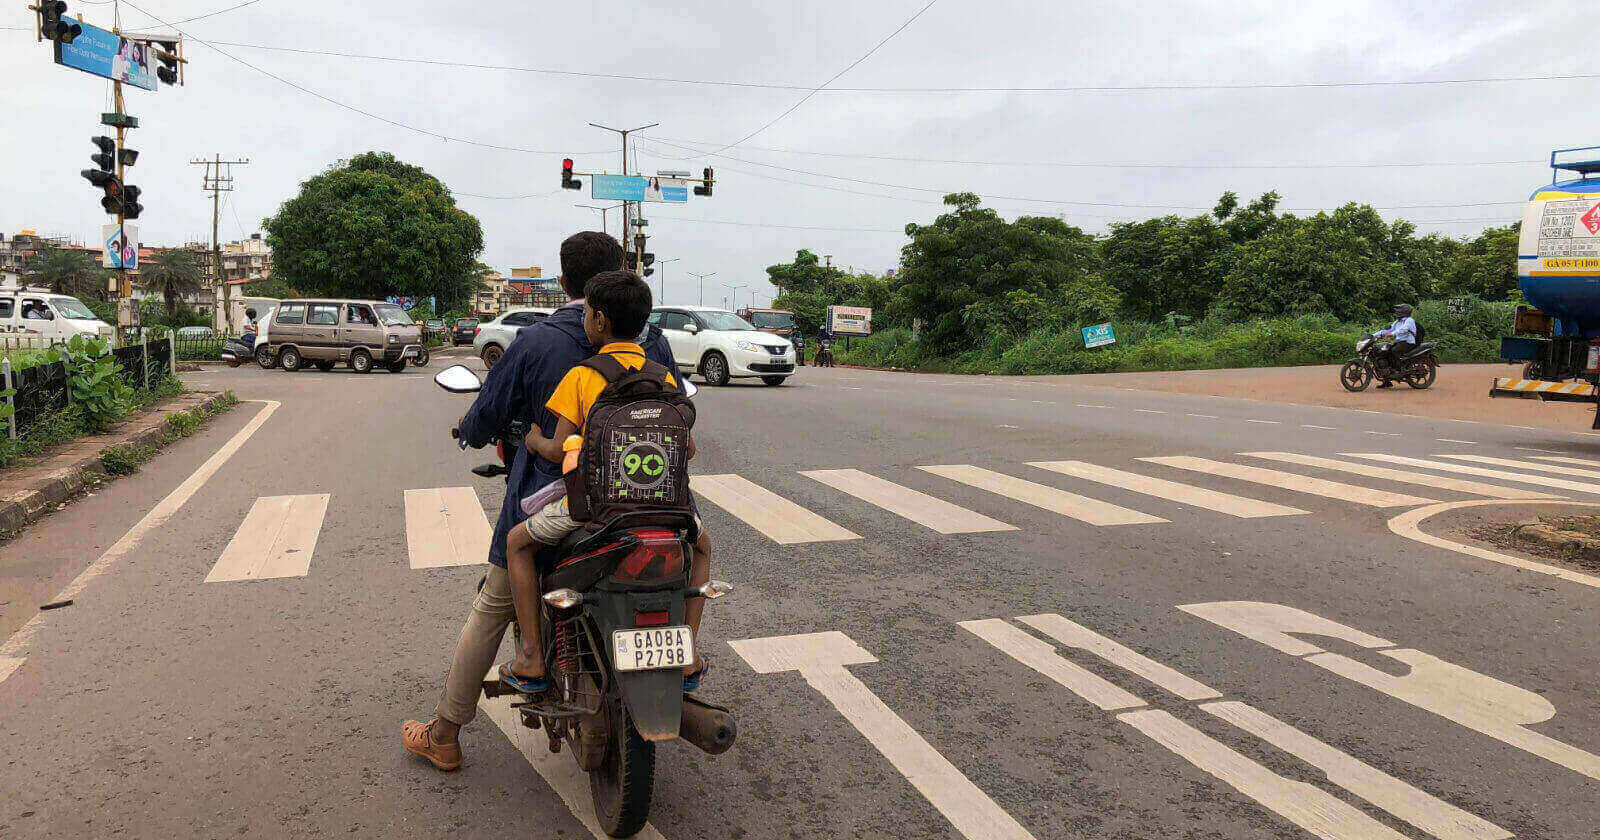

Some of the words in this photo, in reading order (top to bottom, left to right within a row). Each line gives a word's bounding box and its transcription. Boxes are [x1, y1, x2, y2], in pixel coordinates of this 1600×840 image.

[1547, 260, 1560, 268] GA
[624, 453, 664, 476] 90
[634, 630, 684, 649] GA08A
[635, 649, 685, 667] P2798
